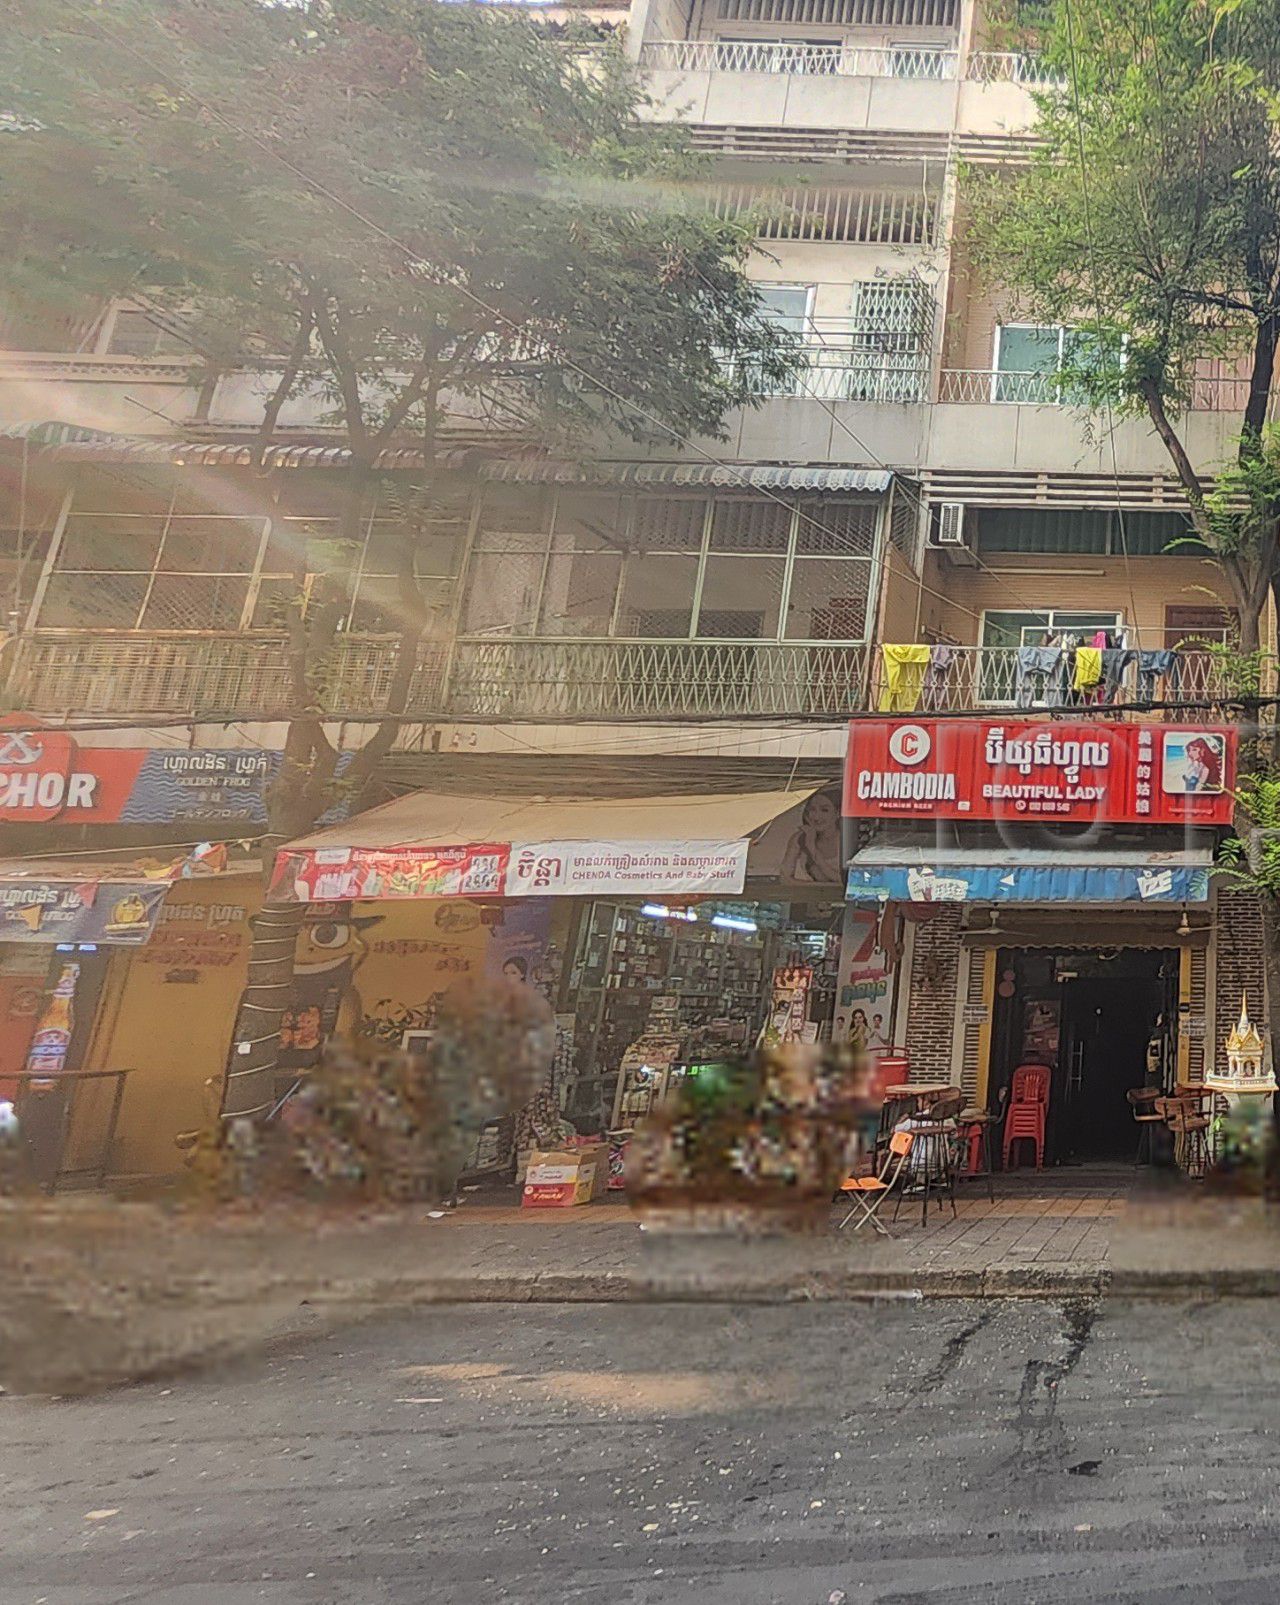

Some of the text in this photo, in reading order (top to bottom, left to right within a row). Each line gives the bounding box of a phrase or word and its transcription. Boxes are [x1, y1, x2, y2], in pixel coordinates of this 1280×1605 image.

[857, 769, 956, 801] CAMBODIA
[982, 784, 1106, 800] BEAUTIFUL LADY
[572, 870, 611, 880] CHENDA
[614, 870, 663, 880] Cosmetics
[665, 870, 684, 880] And
[710, 869, 735, 880] Stuff
